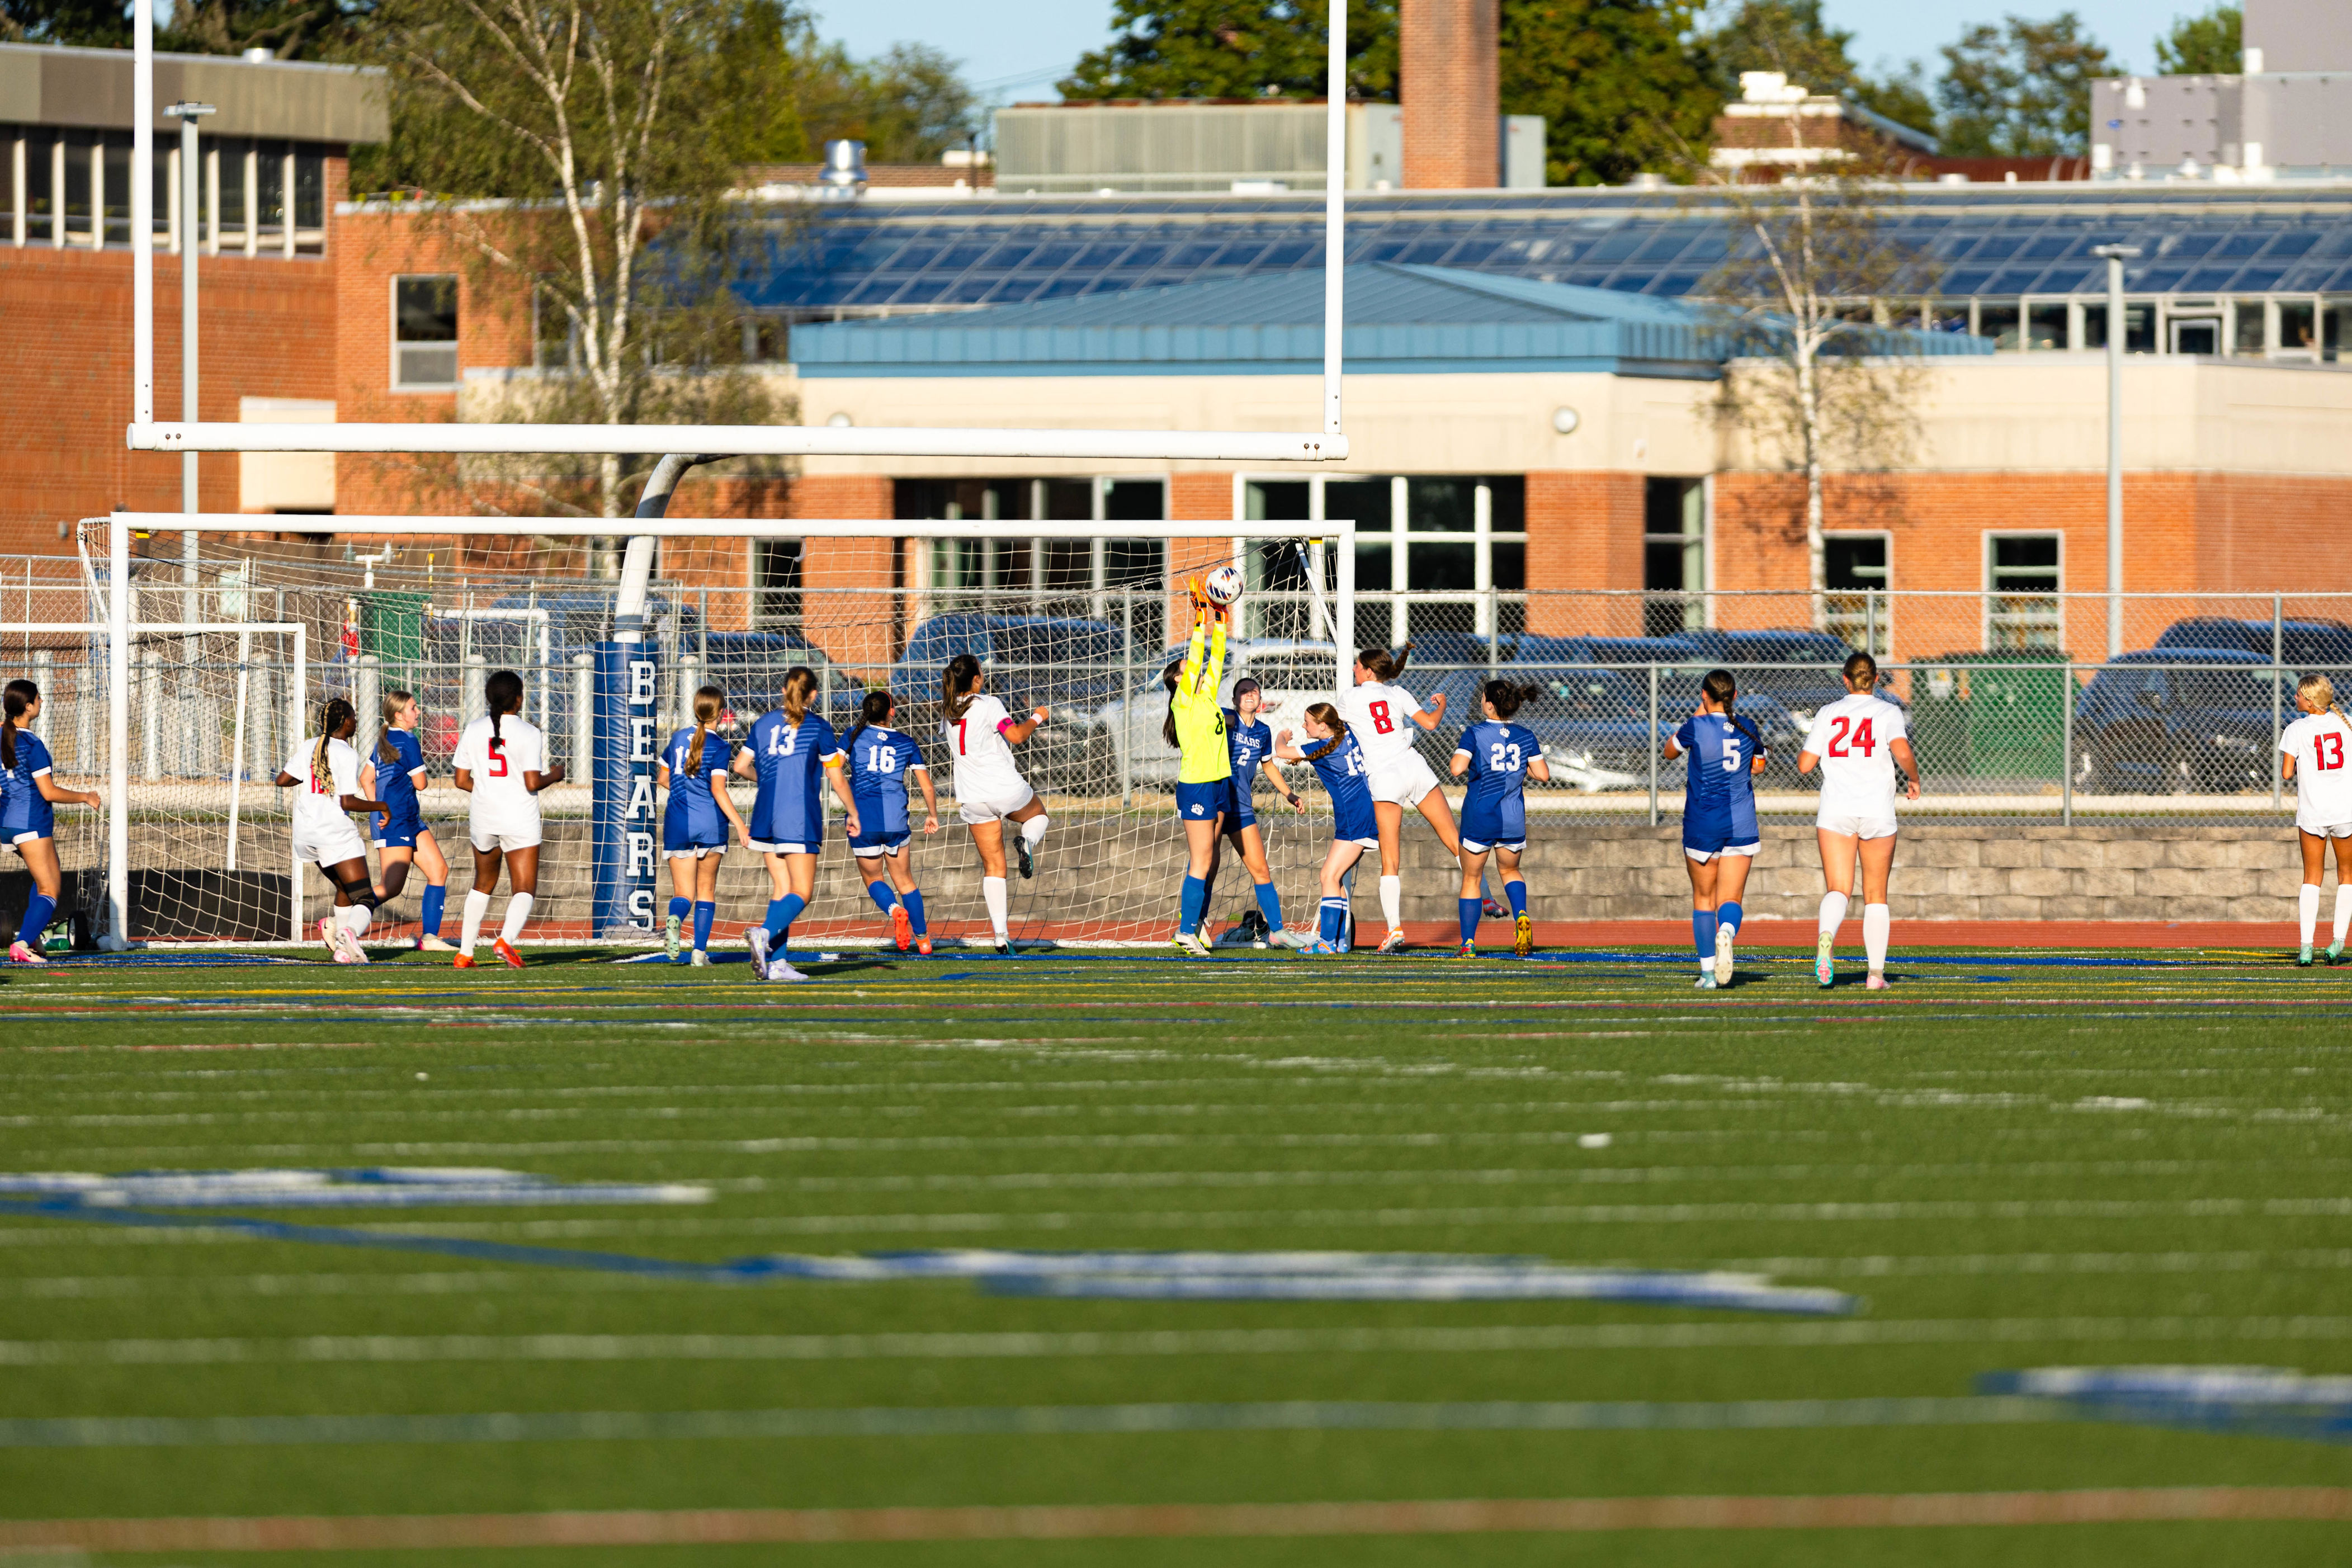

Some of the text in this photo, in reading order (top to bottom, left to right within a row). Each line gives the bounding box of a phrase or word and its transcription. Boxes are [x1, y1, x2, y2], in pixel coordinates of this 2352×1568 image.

[1369, 700, 1395, 734] 8
[768, 725, 797, 755] 13
[952, 718, 967, 755] 7
[1232, 731, 1260, 748] BEARS
[1829, 716, 1876, 757] 24
[2314, 731, 2344, 771] 13
[489, 737, 508, 777] 5
[674, 745, 695, 779] 1
[867, 745, 896, 773] 16
[1237, 747, 1251, 767] 2
[1491, 743, 1520, 771] 23
[1723, 739, 1741, 771] 5
[626, 661, 656, 932] BEARS
